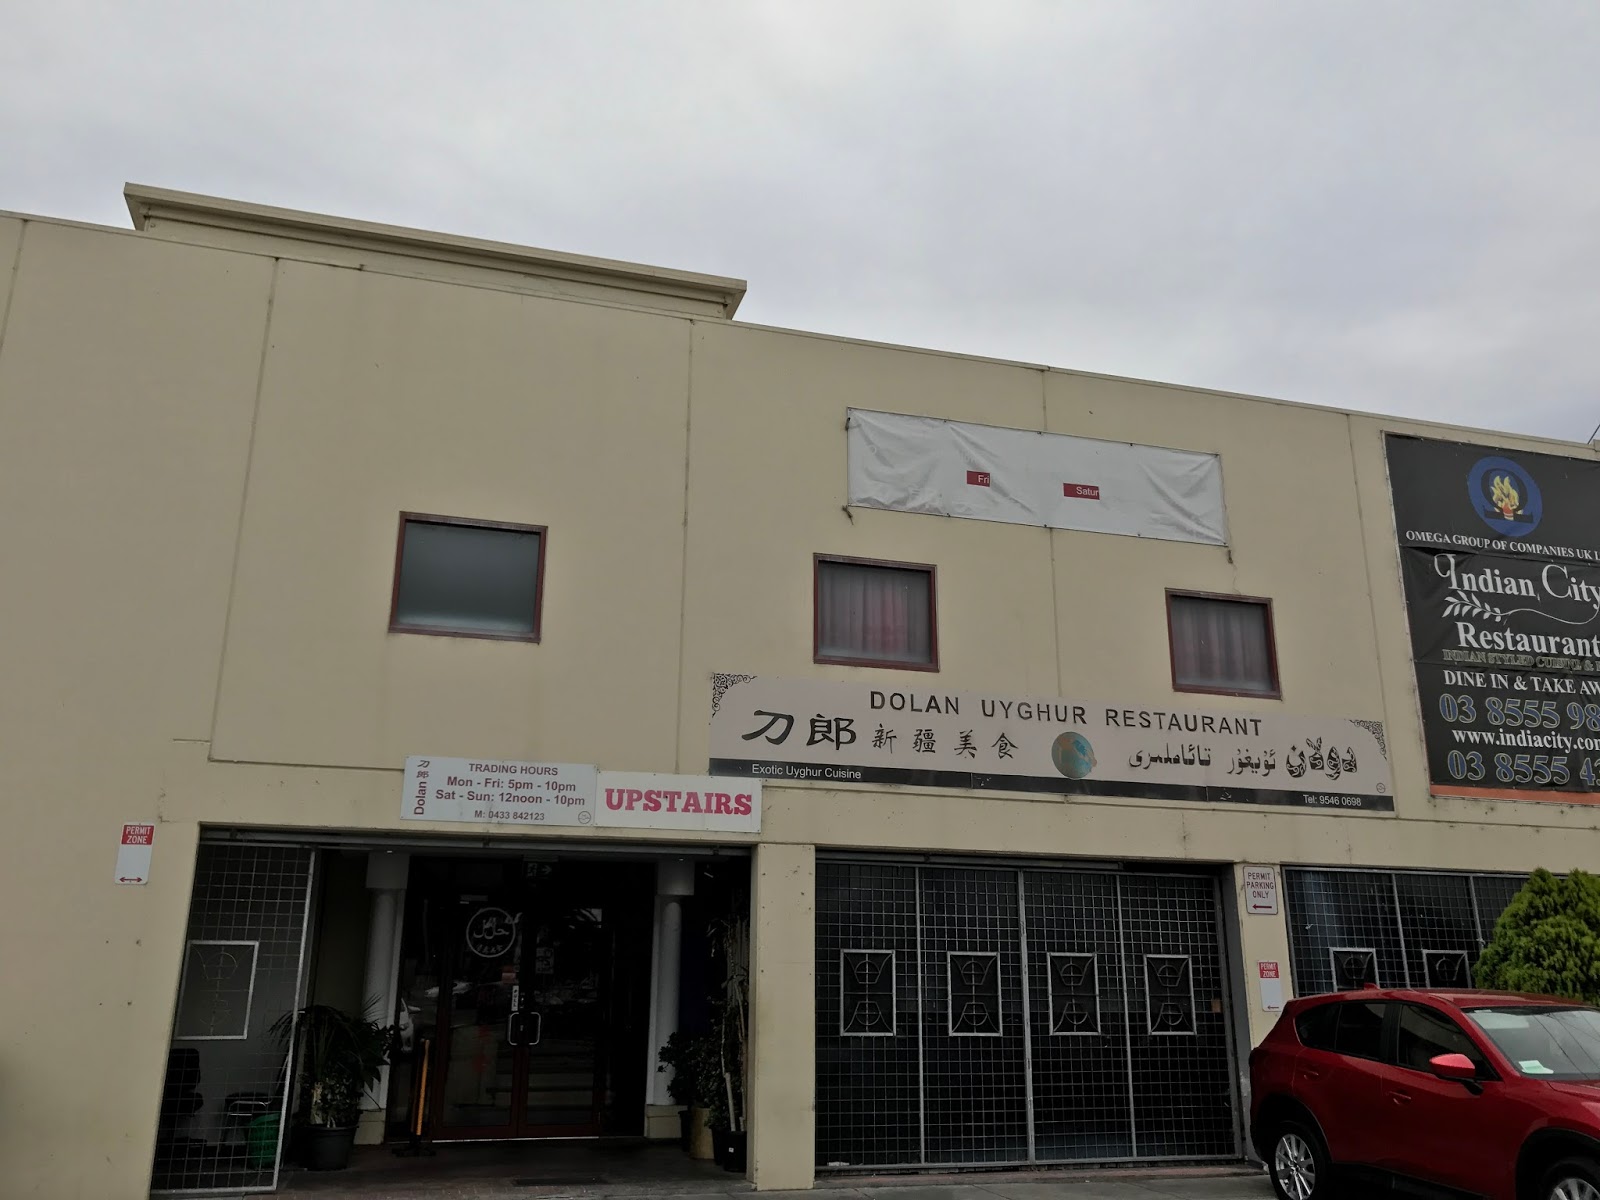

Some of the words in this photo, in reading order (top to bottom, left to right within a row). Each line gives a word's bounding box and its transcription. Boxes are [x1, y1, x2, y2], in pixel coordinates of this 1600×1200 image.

[978, 474, 990, 484] Fri
[1076, 486, 1099, 497] Satur
[1406, 530, 1451, 544] OMEGA
[1452, 534, 1490, 549] GROUP
[1492, 539, 1508, 550] OF
[1509, 541, 1575, 558] COMPANIES
[1576, 549, 1593, 560] UK
[1434, 553, 1537, 597] Indian
[1541, 564, 1600, 610] City
[1455, 621, 1600, 658] Restaurant
[1442, 649, 1487, 664] INDIAN
[1443, 669, 1487, 688] DINE
[1490, 673, 1509, 690] IN
[1513, 675, 1528, 690] &
[1530, 676, 1576, 694] TAKE
[870, 690, 960, 715] DOLAN
[981, 699, 1087, 725] UYGHUR
[1105, 708, 1262, 737] RESTAURANT
[1439, 693, 1477, 724] 03
[1485, 696, 1560, 729] 8555
[1566, 702, 1600, 732] 98
[741, 709, 857, 751] 刀郎
[871, 723, 1018, 760] 新疆美食
[469, 763, 517, 774] TRADING
[520, 766, 558, 776] HOURS
[752, 763, 783, 775] Exotic
[785, 764, 822, 779] Uyghur
[824, 767, 862, 780] Cuisine
[1447, 750, 1485, 781] 03
[1494, 753, 1570, 785] 8555
[447, 776, 473, 787] Mon
[484, 778, 504, 789] Fri:
[508, 780, 533, 792] 5pm
[545, 781, 576, 793] 10pm
[414, 781, 427, 815] Dolan
[436, 789, 456, 800] Sat
[467, 791, 494, 802] Sun:
[499, 792, 542, 804] 12noon
[554, 795, 585, 807] 10pm
[604, 787, 753, 816] UPSTAIRS
[1303, 794, 1318, 804] Tel:
[1319, 795, 1340, 805] 9546
[1341, 796, 1362, 806] 0698
[474, 810, 485, 819] M:
[488, 811, 510, 819] 0433
[513, 812, 545, 821] 842123
[126, 826, 151, 835] PERMIT
[127, 835, 148, 844] ZONE
[1248, 872, 1271, 880] PERMIT
[1247, 881, 1274, 890] PARKING
[1253, 890, 1269, 899] ONLY
[1260, 963, 1276, 971] PERMIT
[1262, 970, 1276, 978] ZONE
